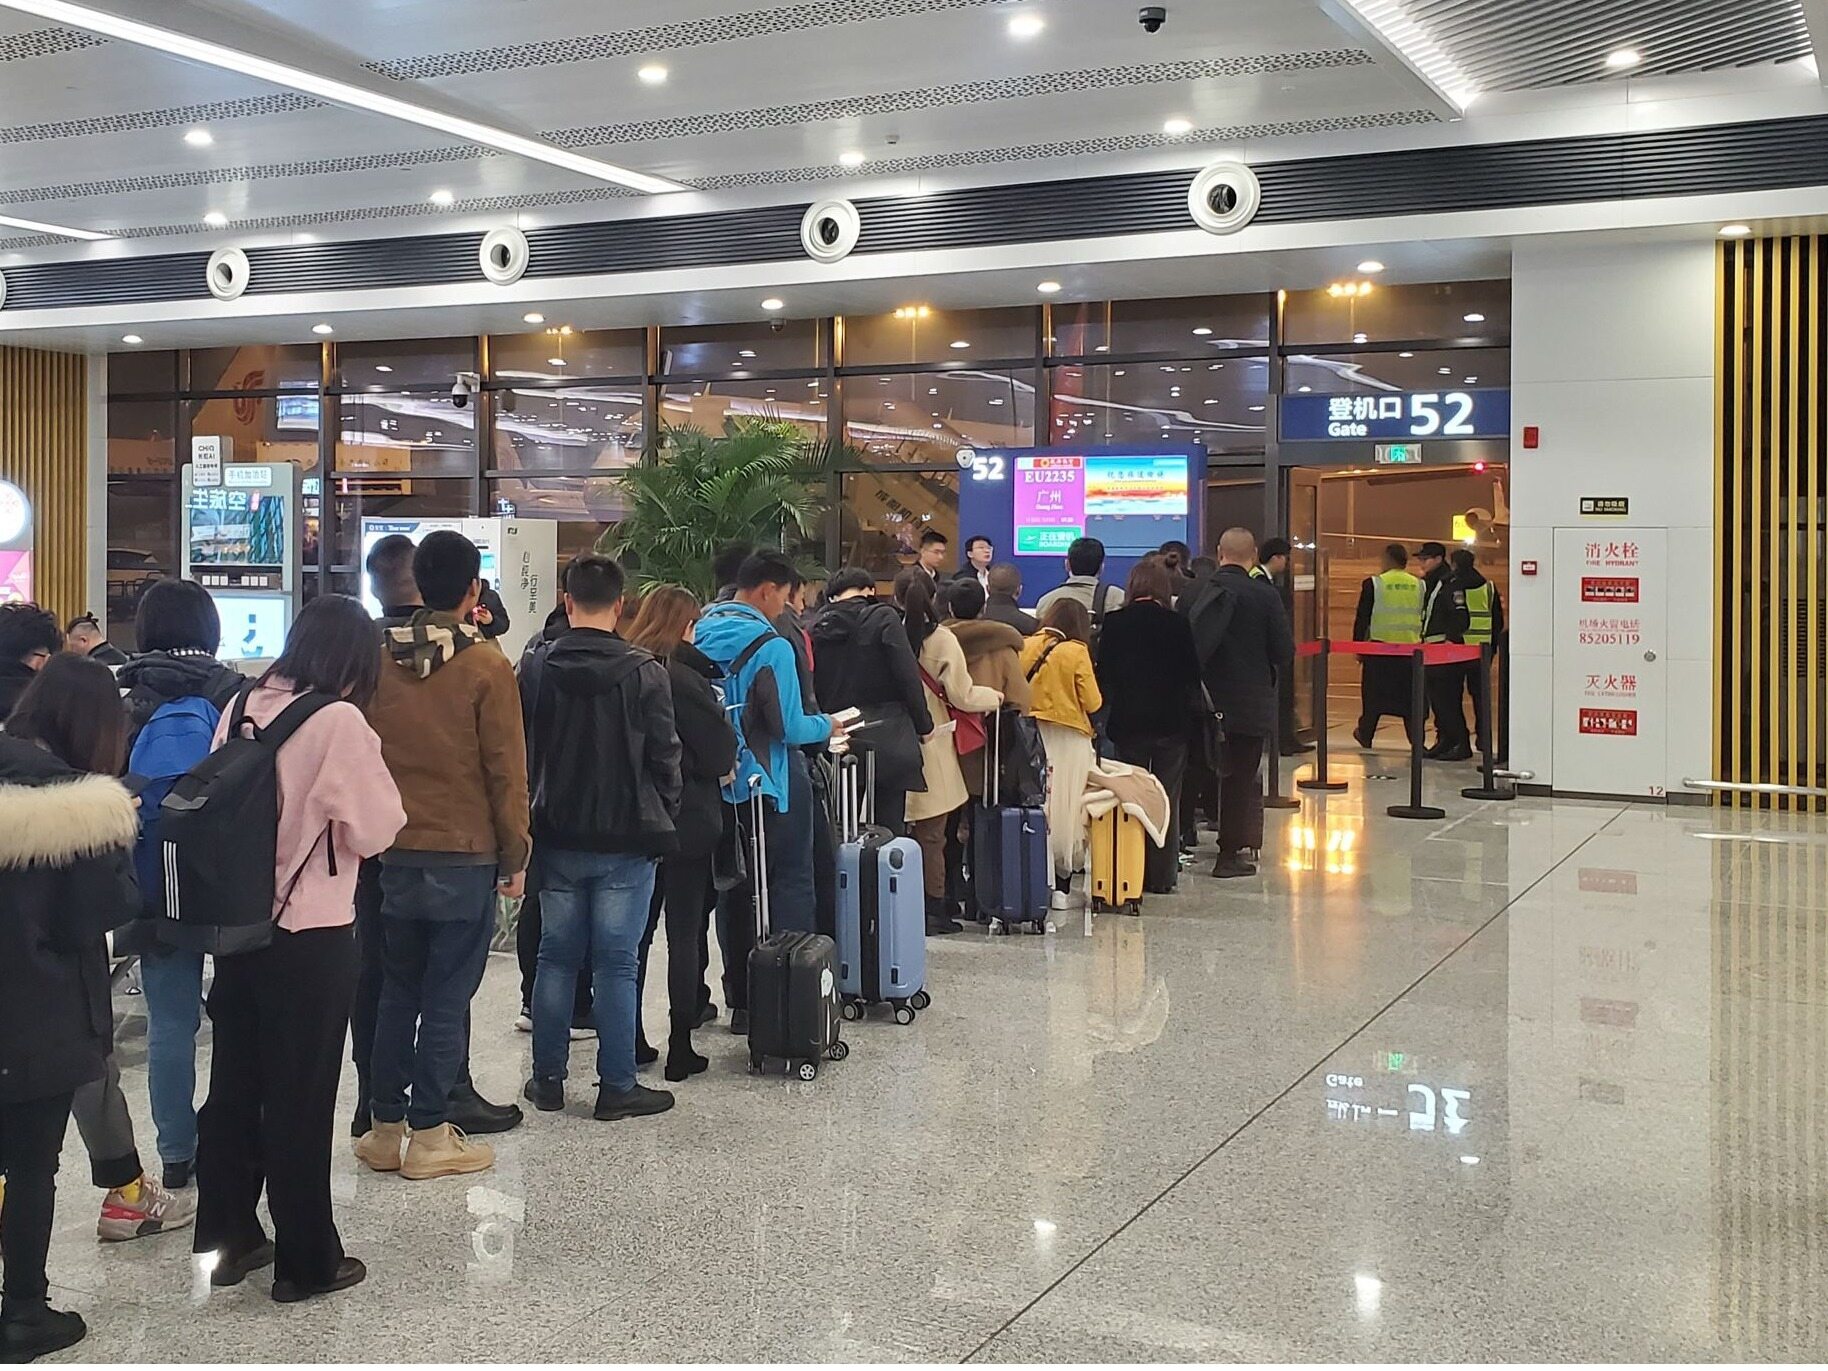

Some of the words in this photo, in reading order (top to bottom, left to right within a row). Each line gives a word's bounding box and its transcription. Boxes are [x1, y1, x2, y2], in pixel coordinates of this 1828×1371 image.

[1328, 397, 1401, 420] 登机口
[1410, 392, 1474, 435] 52
[1328, 422, 1368, 437] Gate
[972, 456, 1005, 480] 52
[1024, 470, 1075, 483] EU2235
[1037, 489, 1062, 503] 广州
[1585, 542, 1639, 559] 消火栓
[1579, 632, 1640, 645] 85205119
[1585, 674, 1637, 691] 灭火器
[1649, 785, 1664, 796] 12
